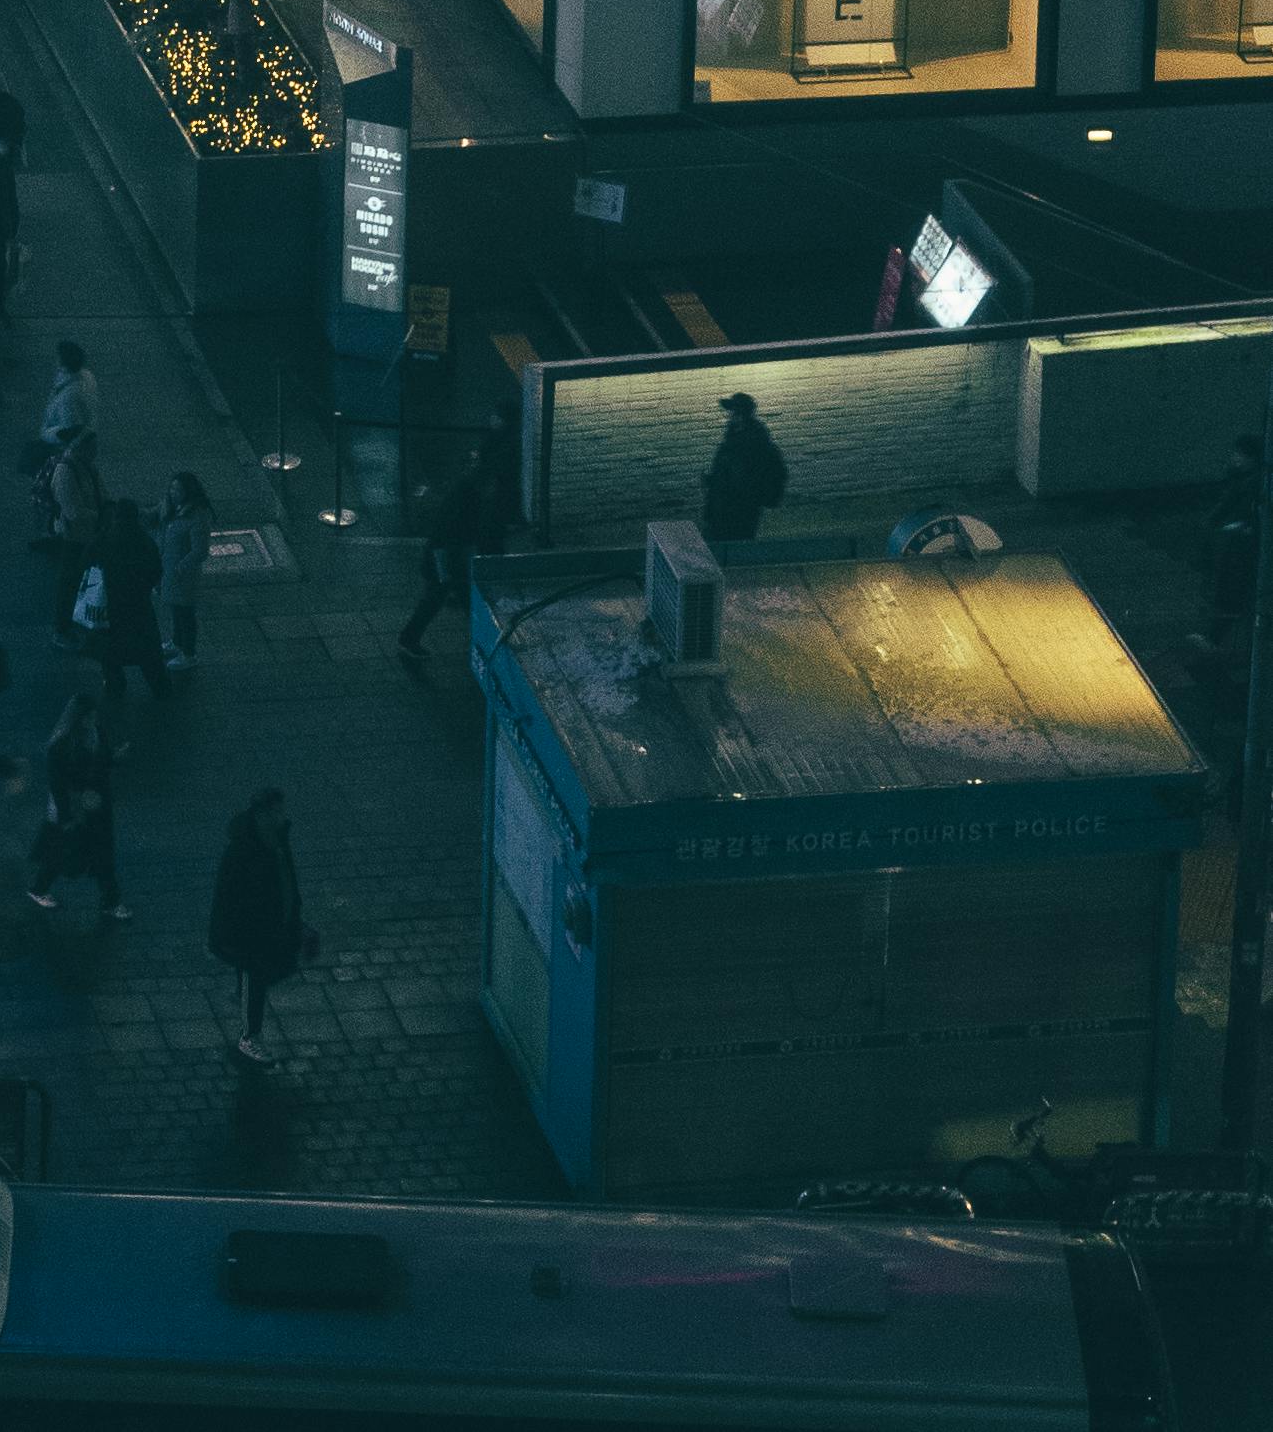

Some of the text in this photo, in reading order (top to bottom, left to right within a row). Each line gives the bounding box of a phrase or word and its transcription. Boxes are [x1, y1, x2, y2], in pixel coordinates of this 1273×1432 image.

[356, 209, 394, 227] MIKADO
[359, 222, 389, 238] SUSHI
[785, 830, 873, 853] KOREA
[889, 820, 999, 846] TOURIST
[1013, 814, 1108, 837] POLICE
